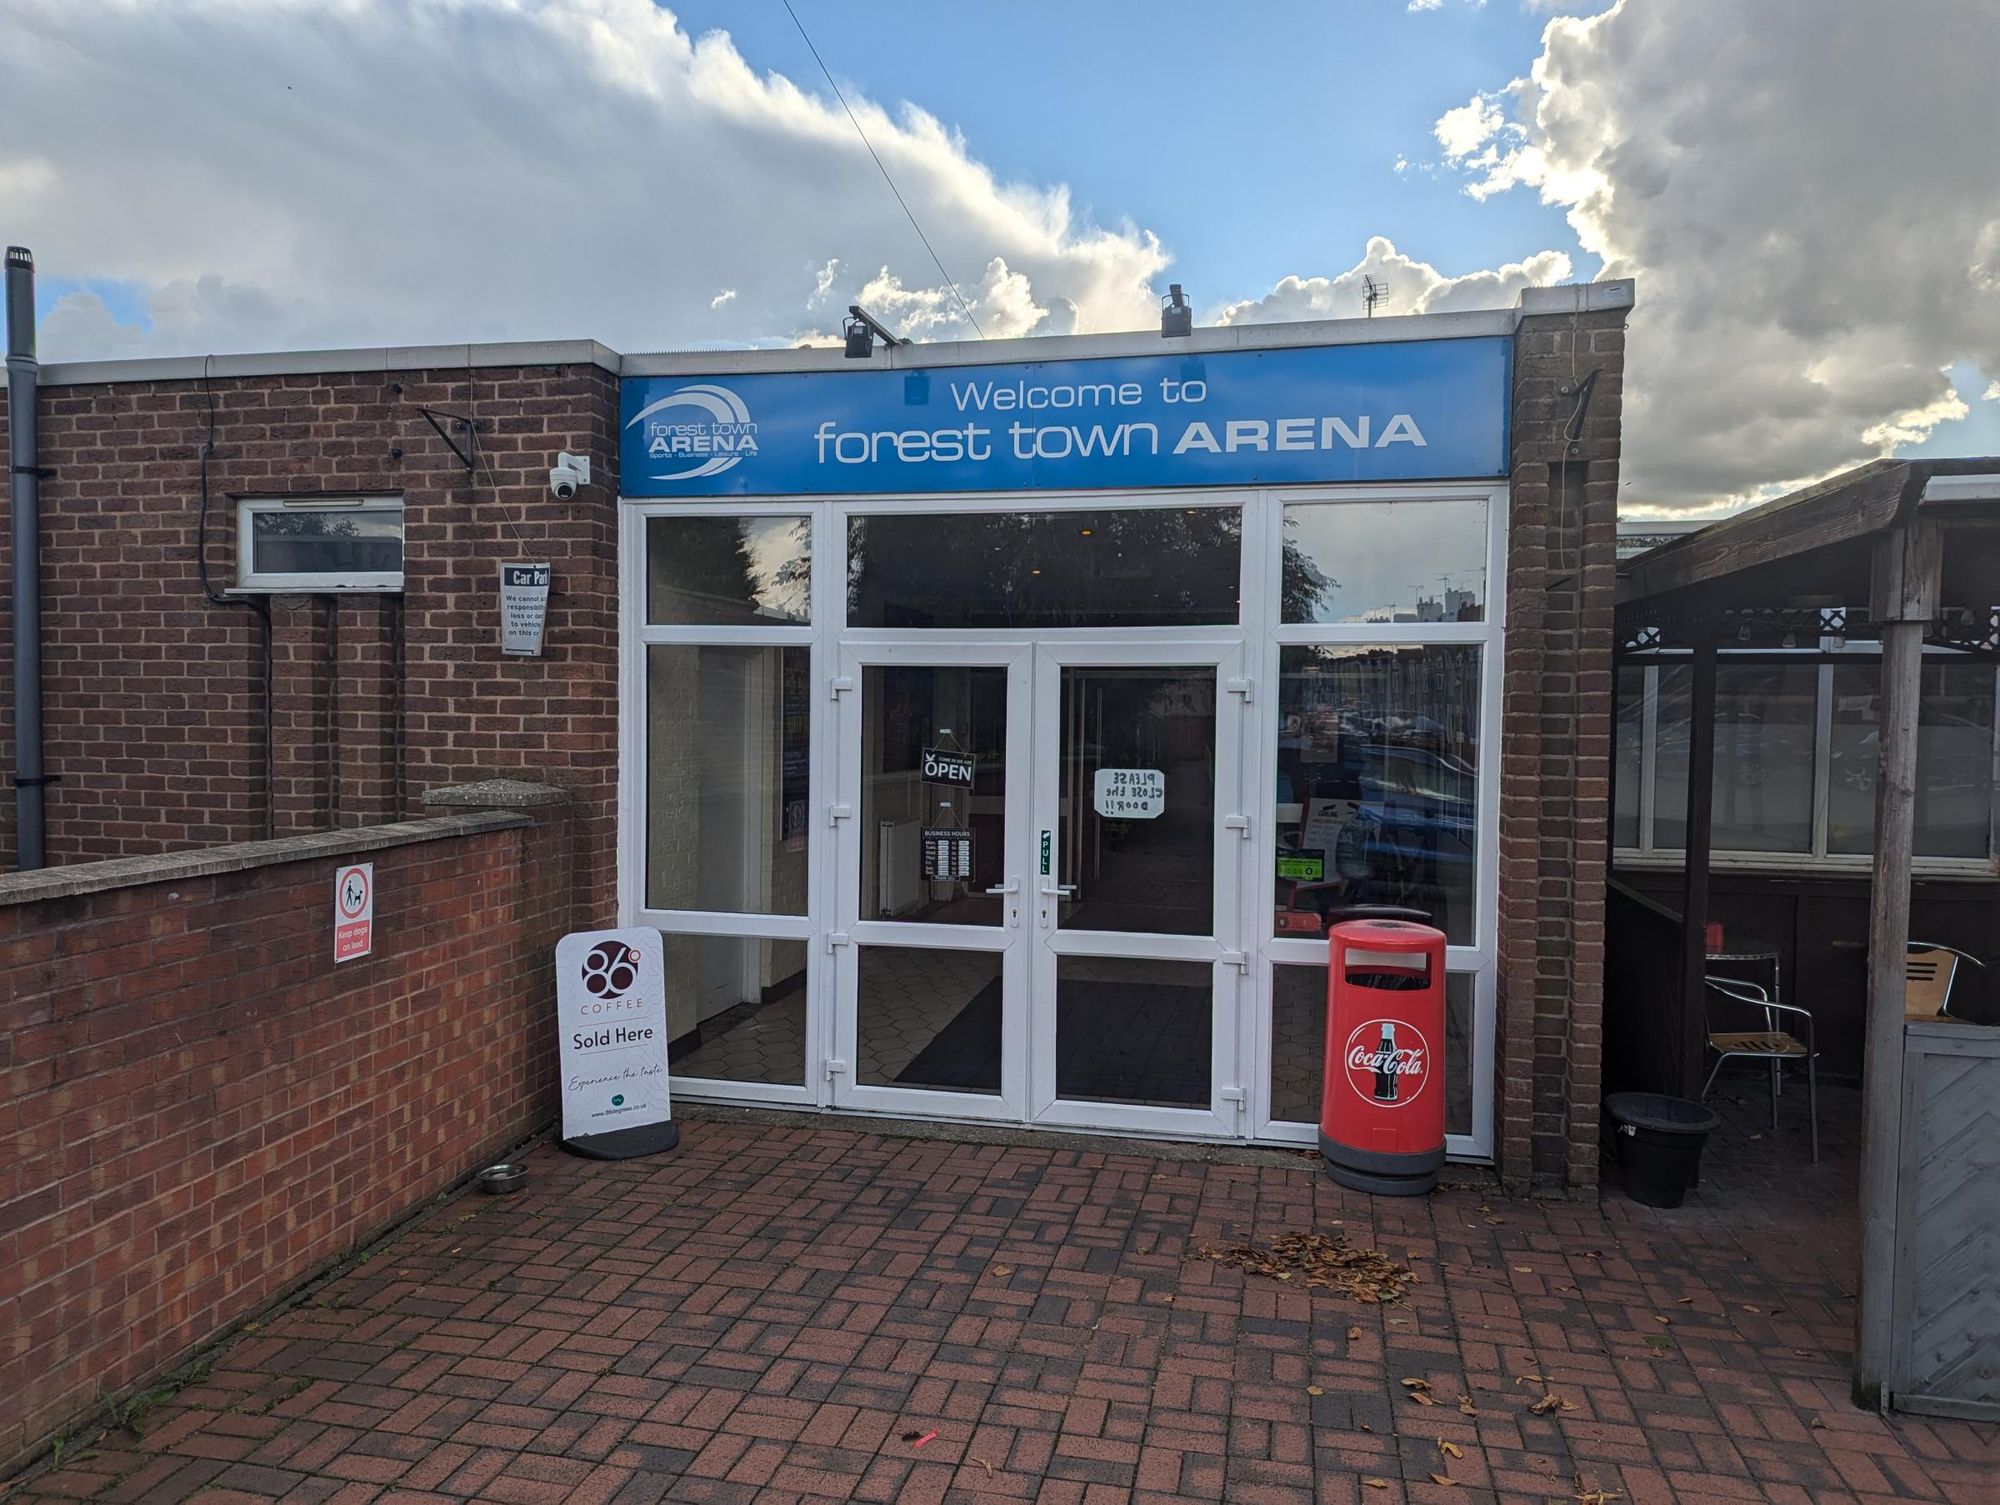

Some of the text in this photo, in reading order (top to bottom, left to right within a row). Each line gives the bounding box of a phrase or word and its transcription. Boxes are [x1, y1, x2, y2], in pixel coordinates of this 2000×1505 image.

[951, 378, 1207, 411] Welcome to
[650, 421, 757, 437] forest town
[648, 434, 758, 453] ARENA
[814, 415, 1427, 463] forest town ARENA
[513, 570, 531, 584] Car
[925, 761, 972, 781] OPEN
[339, 930, 352, 939] Keep
[343, 943, 350, 951] on
[580, 998, 643, 1015] COFFEE
[573, 1027, 653, 1050] Sold Here
[1348, 1045, 1424, 1075] Coca-Cola
[568, 1063, 662, 1091] Experience the taste
